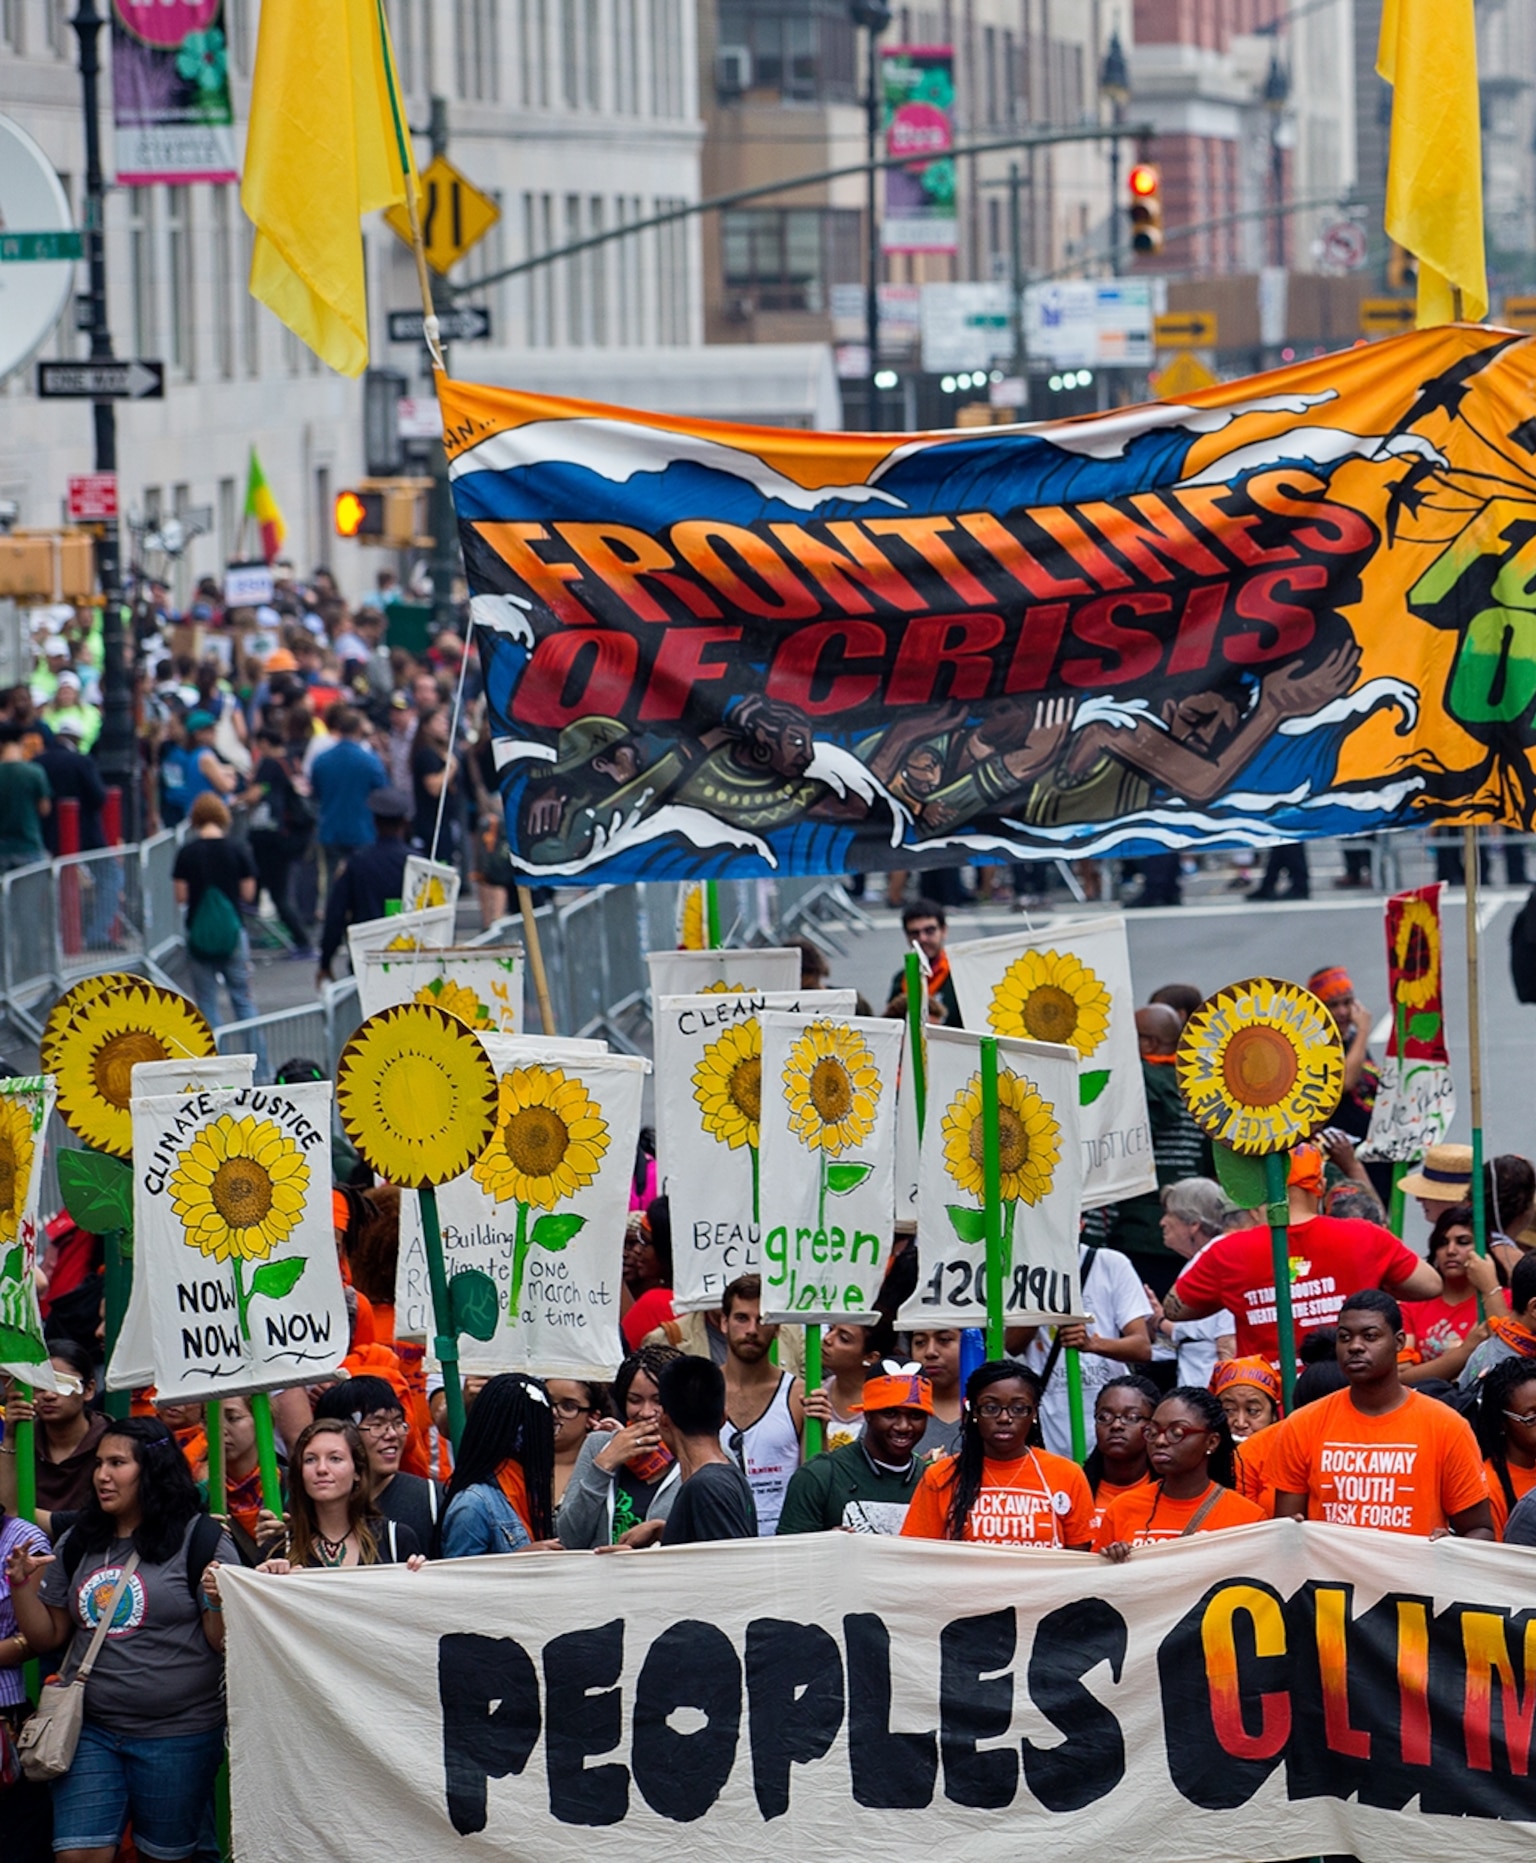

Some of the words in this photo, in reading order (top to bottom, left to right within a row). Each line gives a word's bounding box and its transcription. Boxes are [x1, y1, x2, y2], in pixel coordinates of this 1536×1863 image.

[473, 468, 1377, 622] FRONTLINES
[510, 626, 744, 729] OF
[766, 565, 1330, 716] CRISIS
[678, 996, 766, 1036] CLEAN
[1235, 994, 1329, 1050] CLIMATE
[1194, 1008, 1231, 1083] WANT
[1197, 1088, 1233, 1136] WE
[143, 1093, 214, 1196] CLIMATE
[234, 1088, 323, 1150] JUSTICE
[444, 1224, 513, 1258] Building
[765, 1225, 880, 1287] green
[177, 1276, 236, 1313] NOW
[786, 1269, 865, 1312] love
[265, 1311, 331, 1347] NOW
[545, 1305, 588, 1328] time
[181, 1324, 241, 1359] NOW
[1321, 1451, 1417, 1474] ROCKAWAY
[1334, 1477, 1395, 1503] YOUTH
[971, 1515, 1035, 1539] YOUTH
[1322, 1502, 1357, 1526] TASK
[1360, 1505, 1413, 1528] FORCE
[438, 1597, 1128, 1836] PEOPLES
